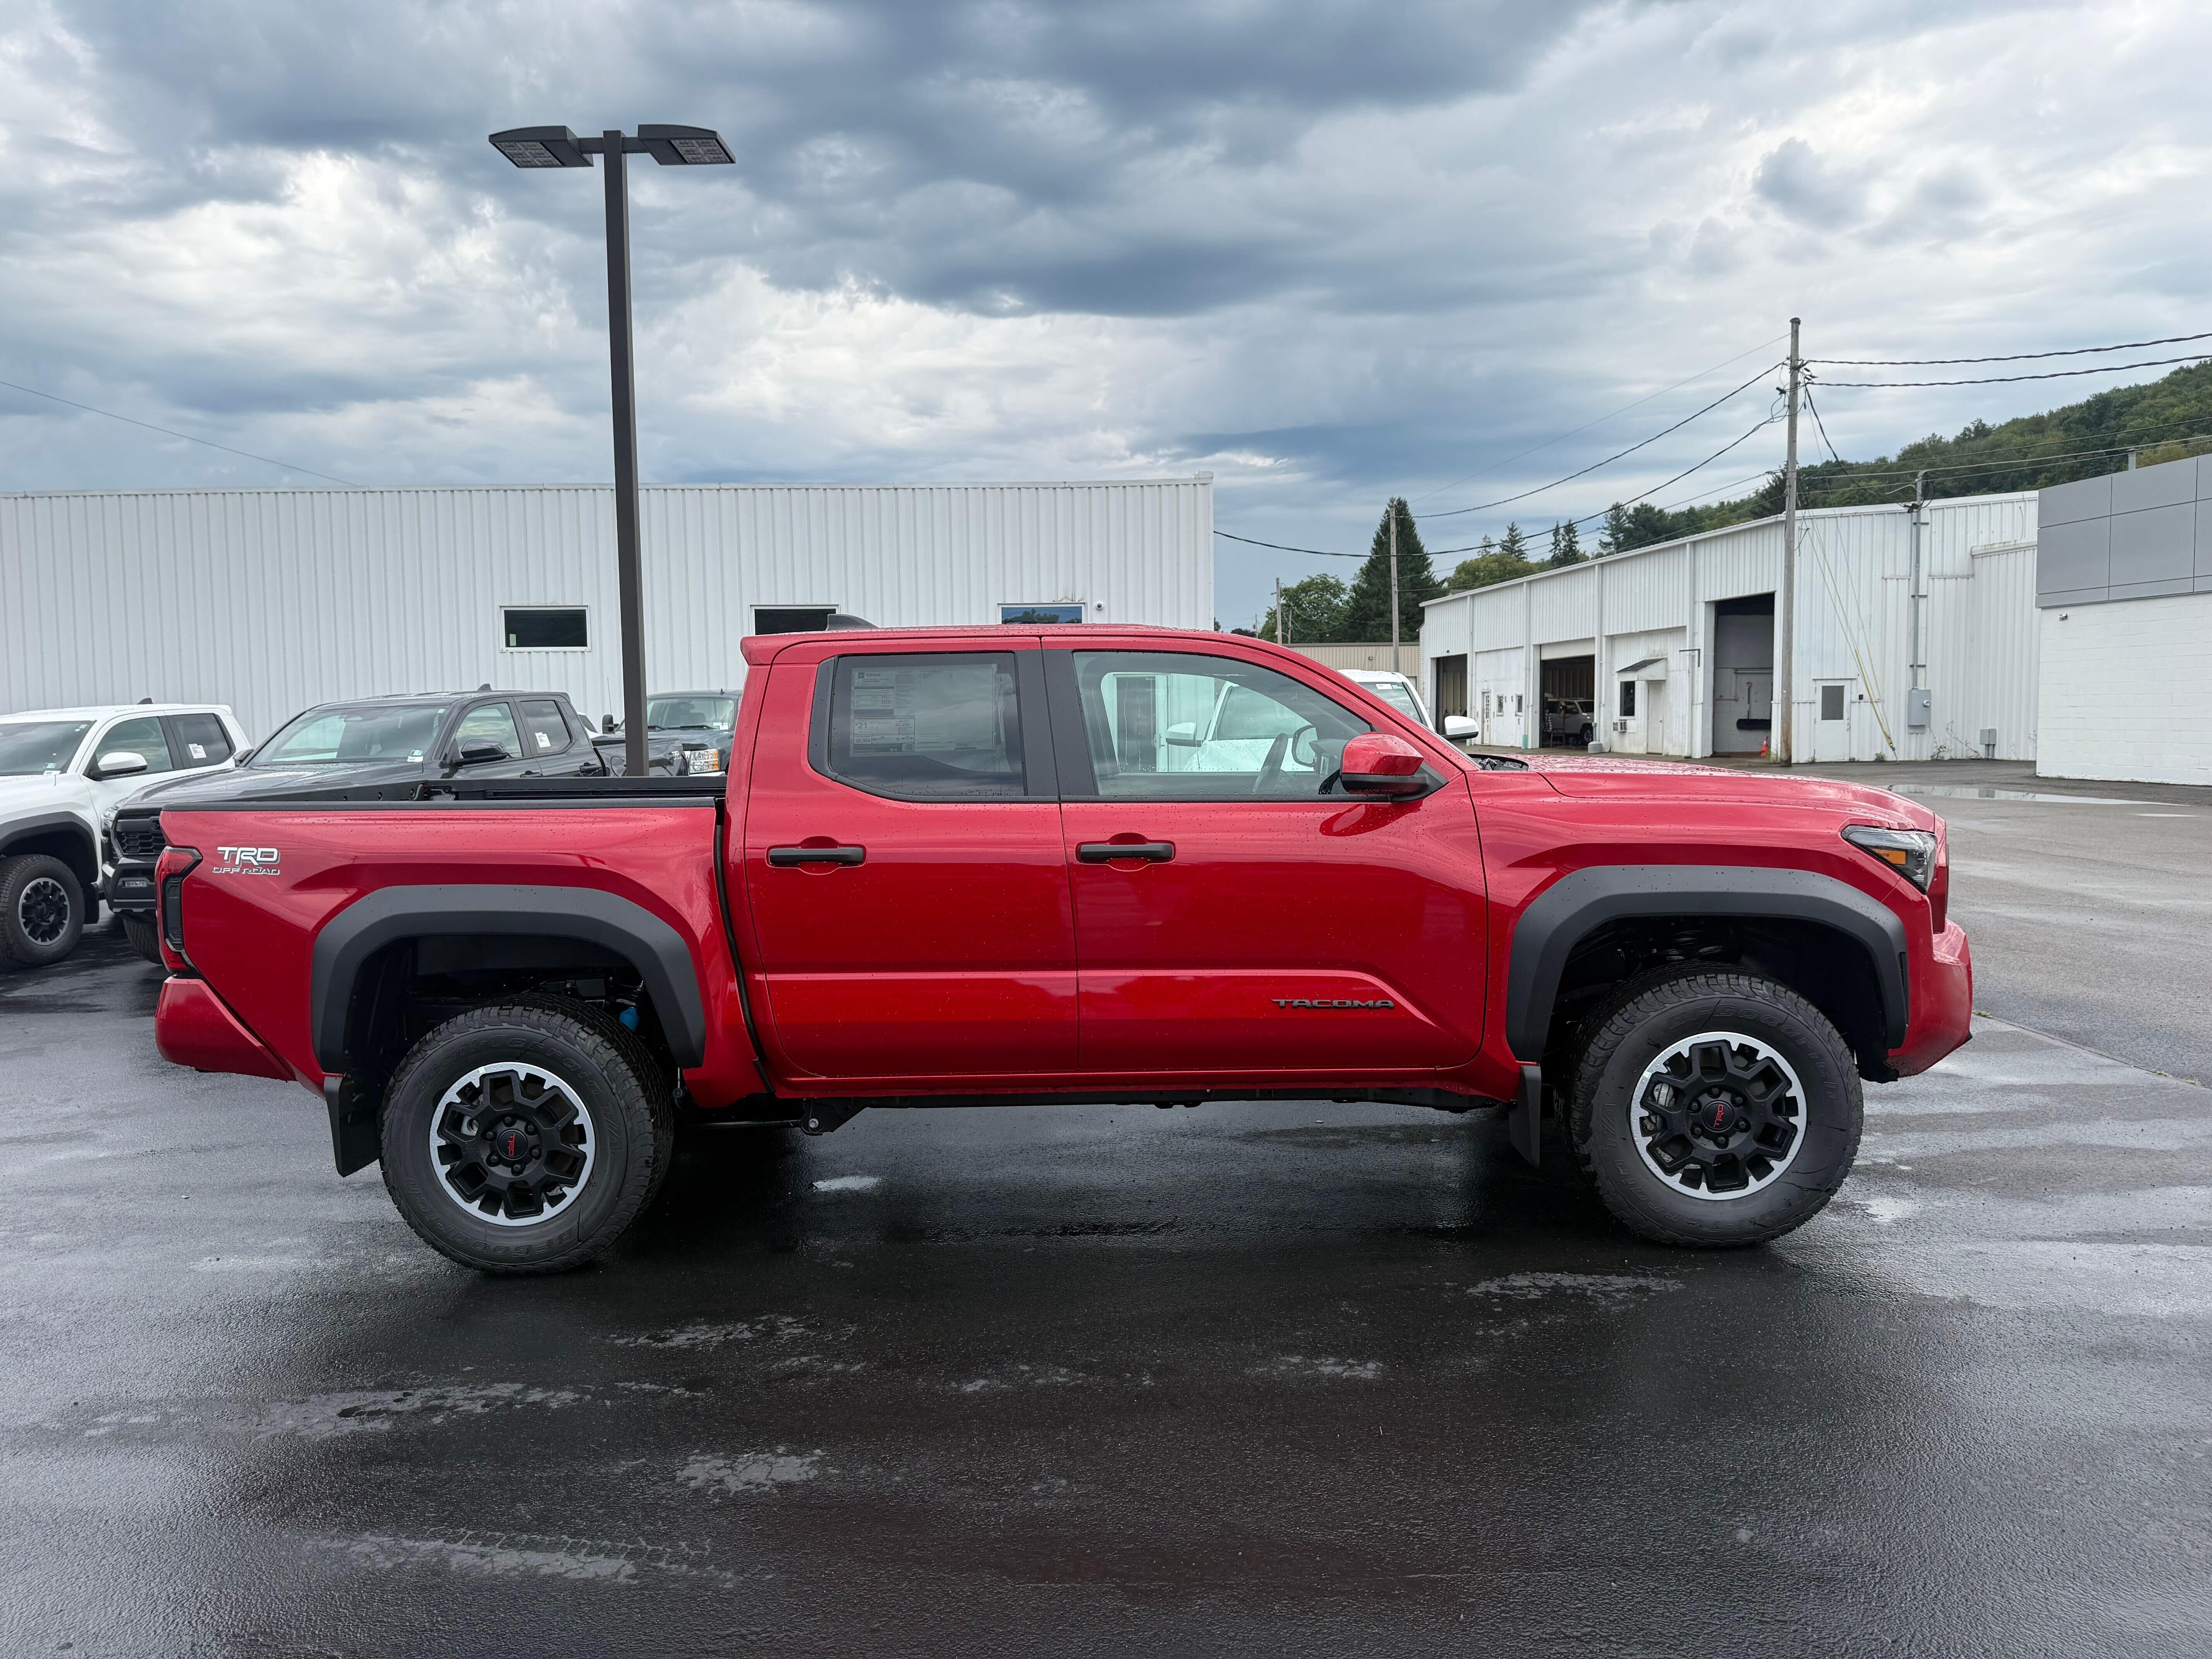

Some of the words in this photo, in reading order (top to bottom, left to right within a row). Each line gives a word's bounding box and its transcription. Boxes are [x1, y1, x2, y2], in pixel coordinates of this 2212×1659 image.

[217, 847, 280, 867] TRD
[1271, 999, 1395, 1008] TACOMA
[1668, 1004, 1836, 1099] BFGoodrich
[1713, 1104, 1724, 1127] TRD
